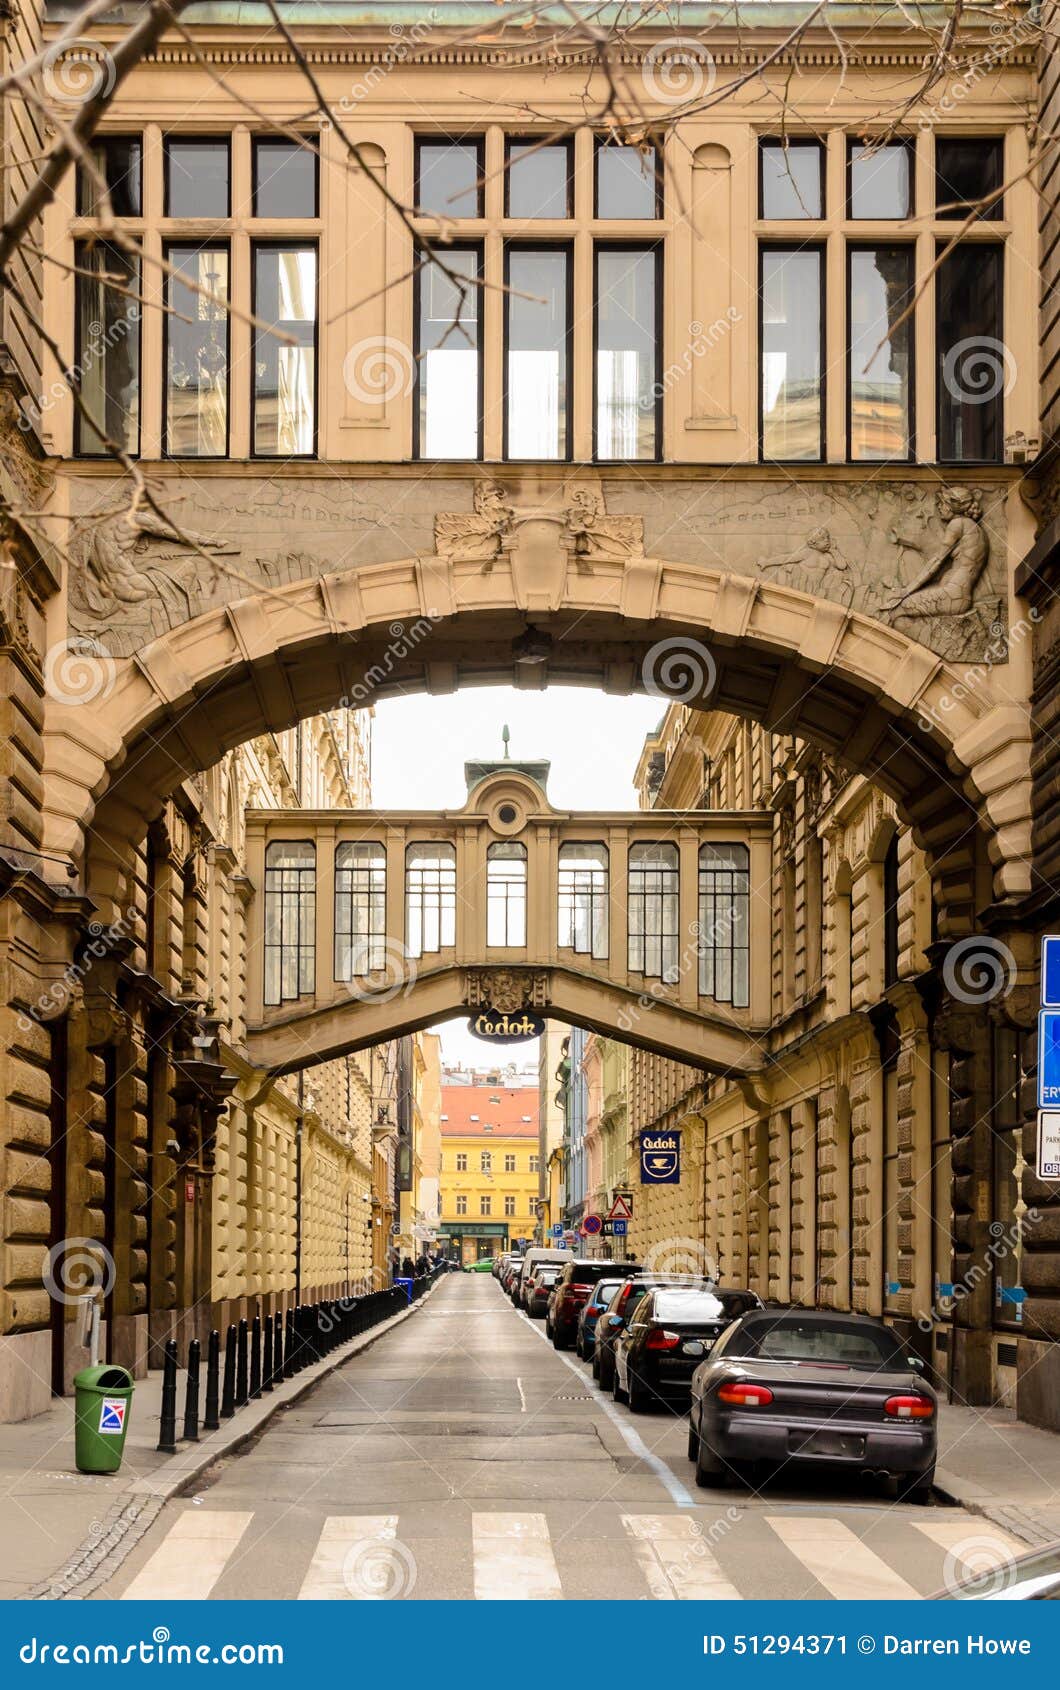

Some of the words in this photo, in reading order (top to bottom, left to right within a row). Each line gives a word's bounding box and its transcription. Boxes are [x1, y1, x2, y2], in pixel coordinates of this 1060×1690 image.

[475, 1014, 536, 1036] Čedok
[1045, 1163, 1060, 1173] OB
[615, 1223, 625, 1232] 20
